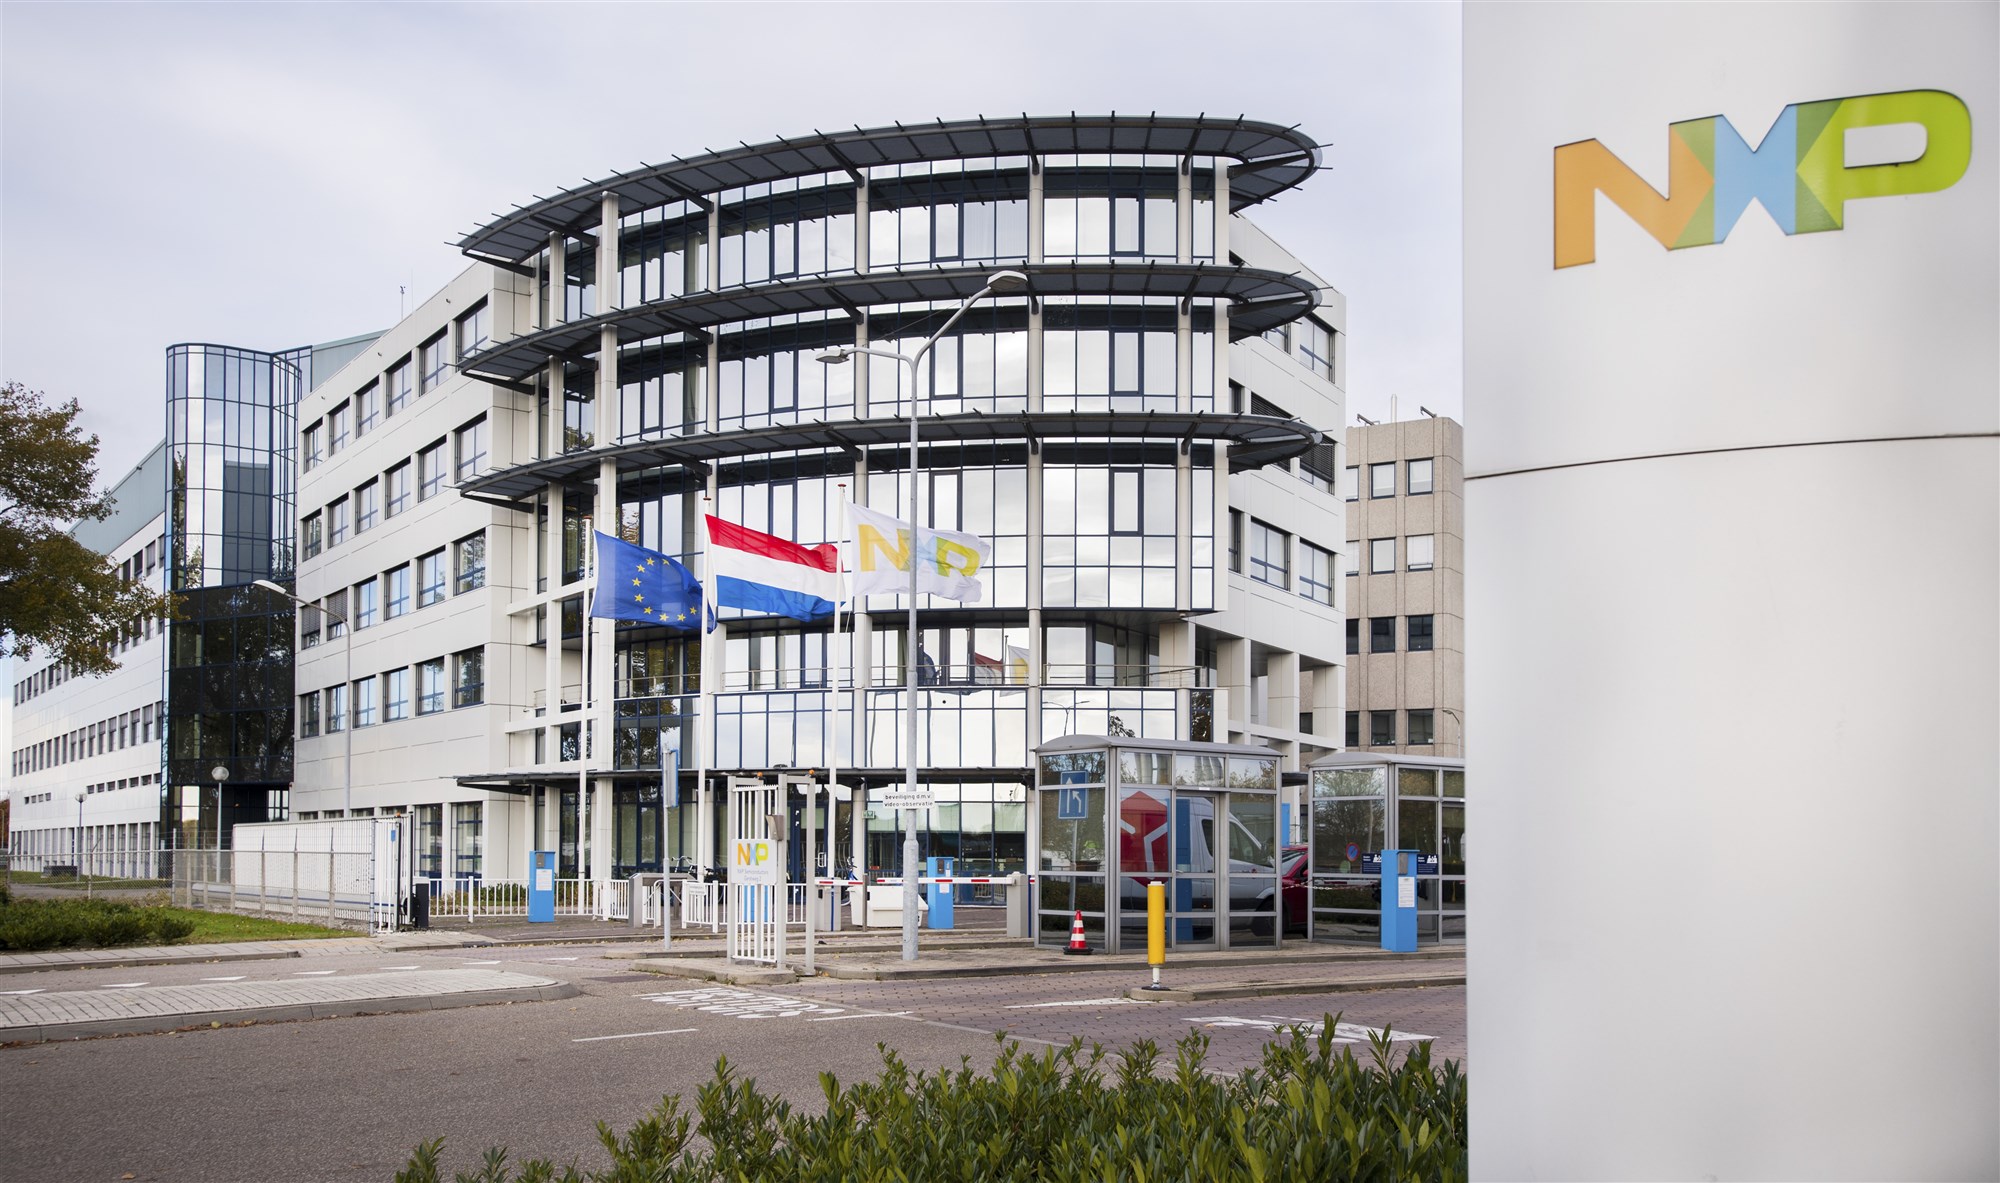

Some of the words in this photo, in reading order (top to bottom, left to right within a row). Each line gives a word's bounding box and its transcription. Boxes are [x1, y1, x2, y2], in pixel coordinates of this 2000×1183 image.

[1554, 88, 1972, 269] NXP
[858, 524, 980, 577] NXP
[737, 843, 768, 866] NXP
